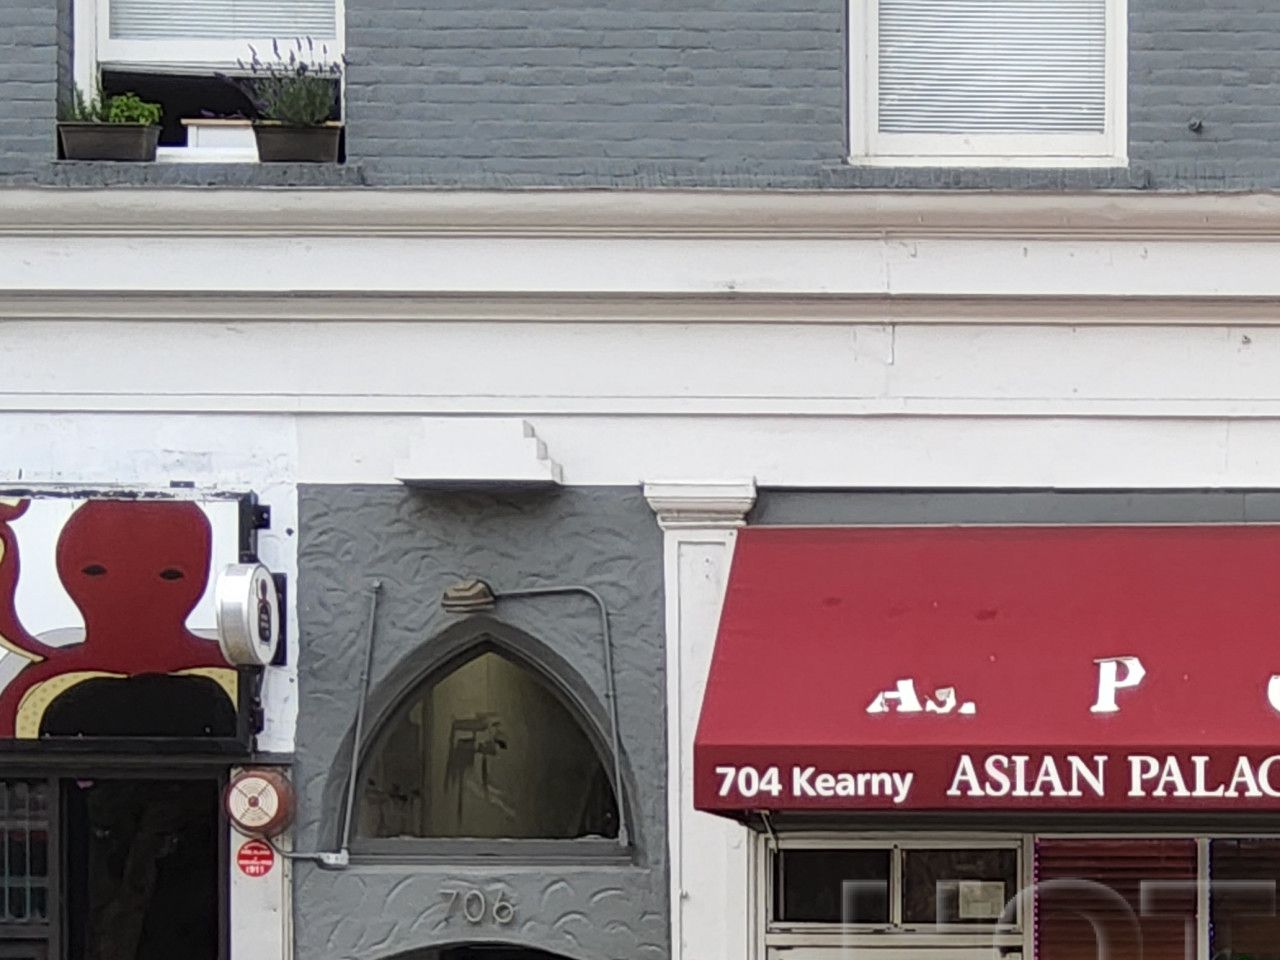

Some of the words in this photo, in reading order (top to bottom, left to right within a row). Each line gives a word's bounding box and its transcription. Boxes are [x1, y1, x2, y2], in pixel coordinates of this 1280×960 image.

[715, 766, 783, 797] 704
[792, 766, 914, 804] Kearny
[946, 754, 1108, 797] ASIAN
[439, 889, 513, 923] 706
